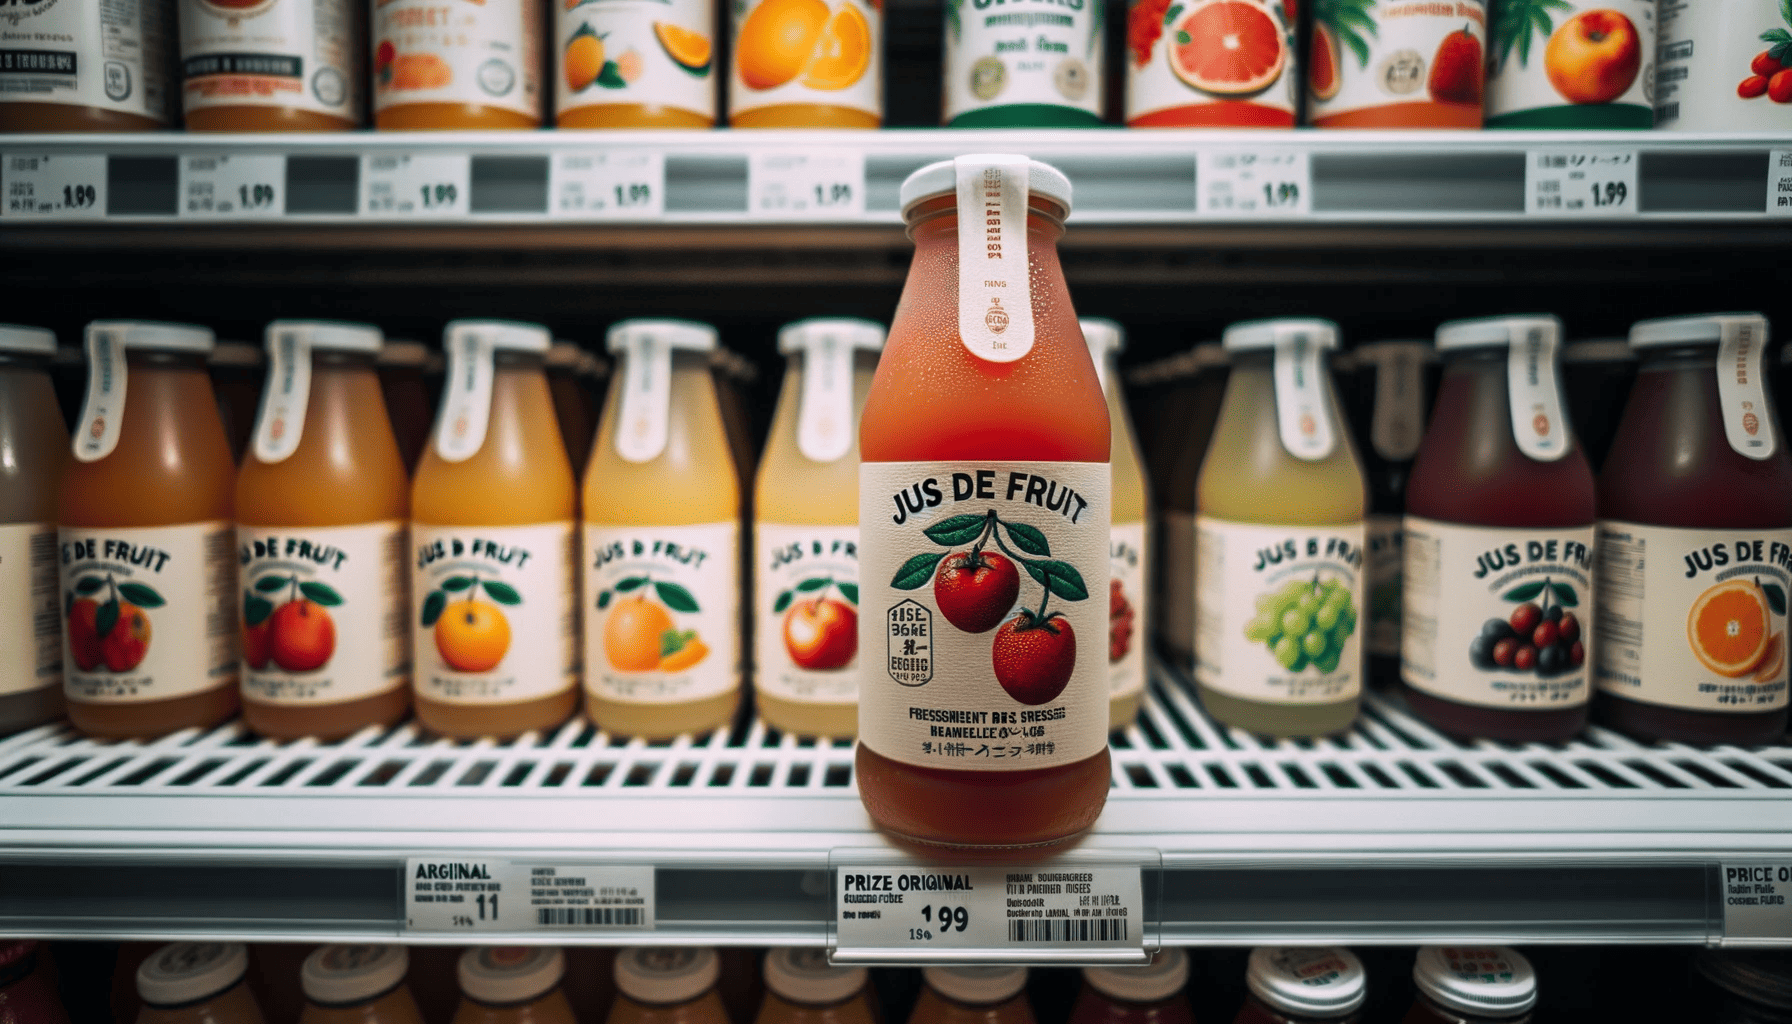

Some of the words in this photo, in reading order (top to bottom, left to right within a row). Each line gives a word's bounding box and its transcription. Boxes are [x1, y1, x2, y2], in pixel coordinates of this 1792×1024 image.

[893, 478, 943, 525] JUS
[952, 470, 995, 501] DE
[1006, 472, 1088, 524] FRUIT
[74, 539, 96, 560] DE
[105, 539, 171, 573] FRUIT
[254, 537, 277, 557] DE
[1254, 537, 1297, 572] JUS
[1473, 543, 1521, 578] JUS
[1527, 539, 1558, 562] DE
[1684, 543, 1729, 578] JUS
[1735, 540, 1764, 562] DE
[845, 874, 893, 891] PRIZE
[1727, 867, 1773, 883] PRICE
[1778, 867, 1792, 882] O
[476, 893, 498, 920] 11
